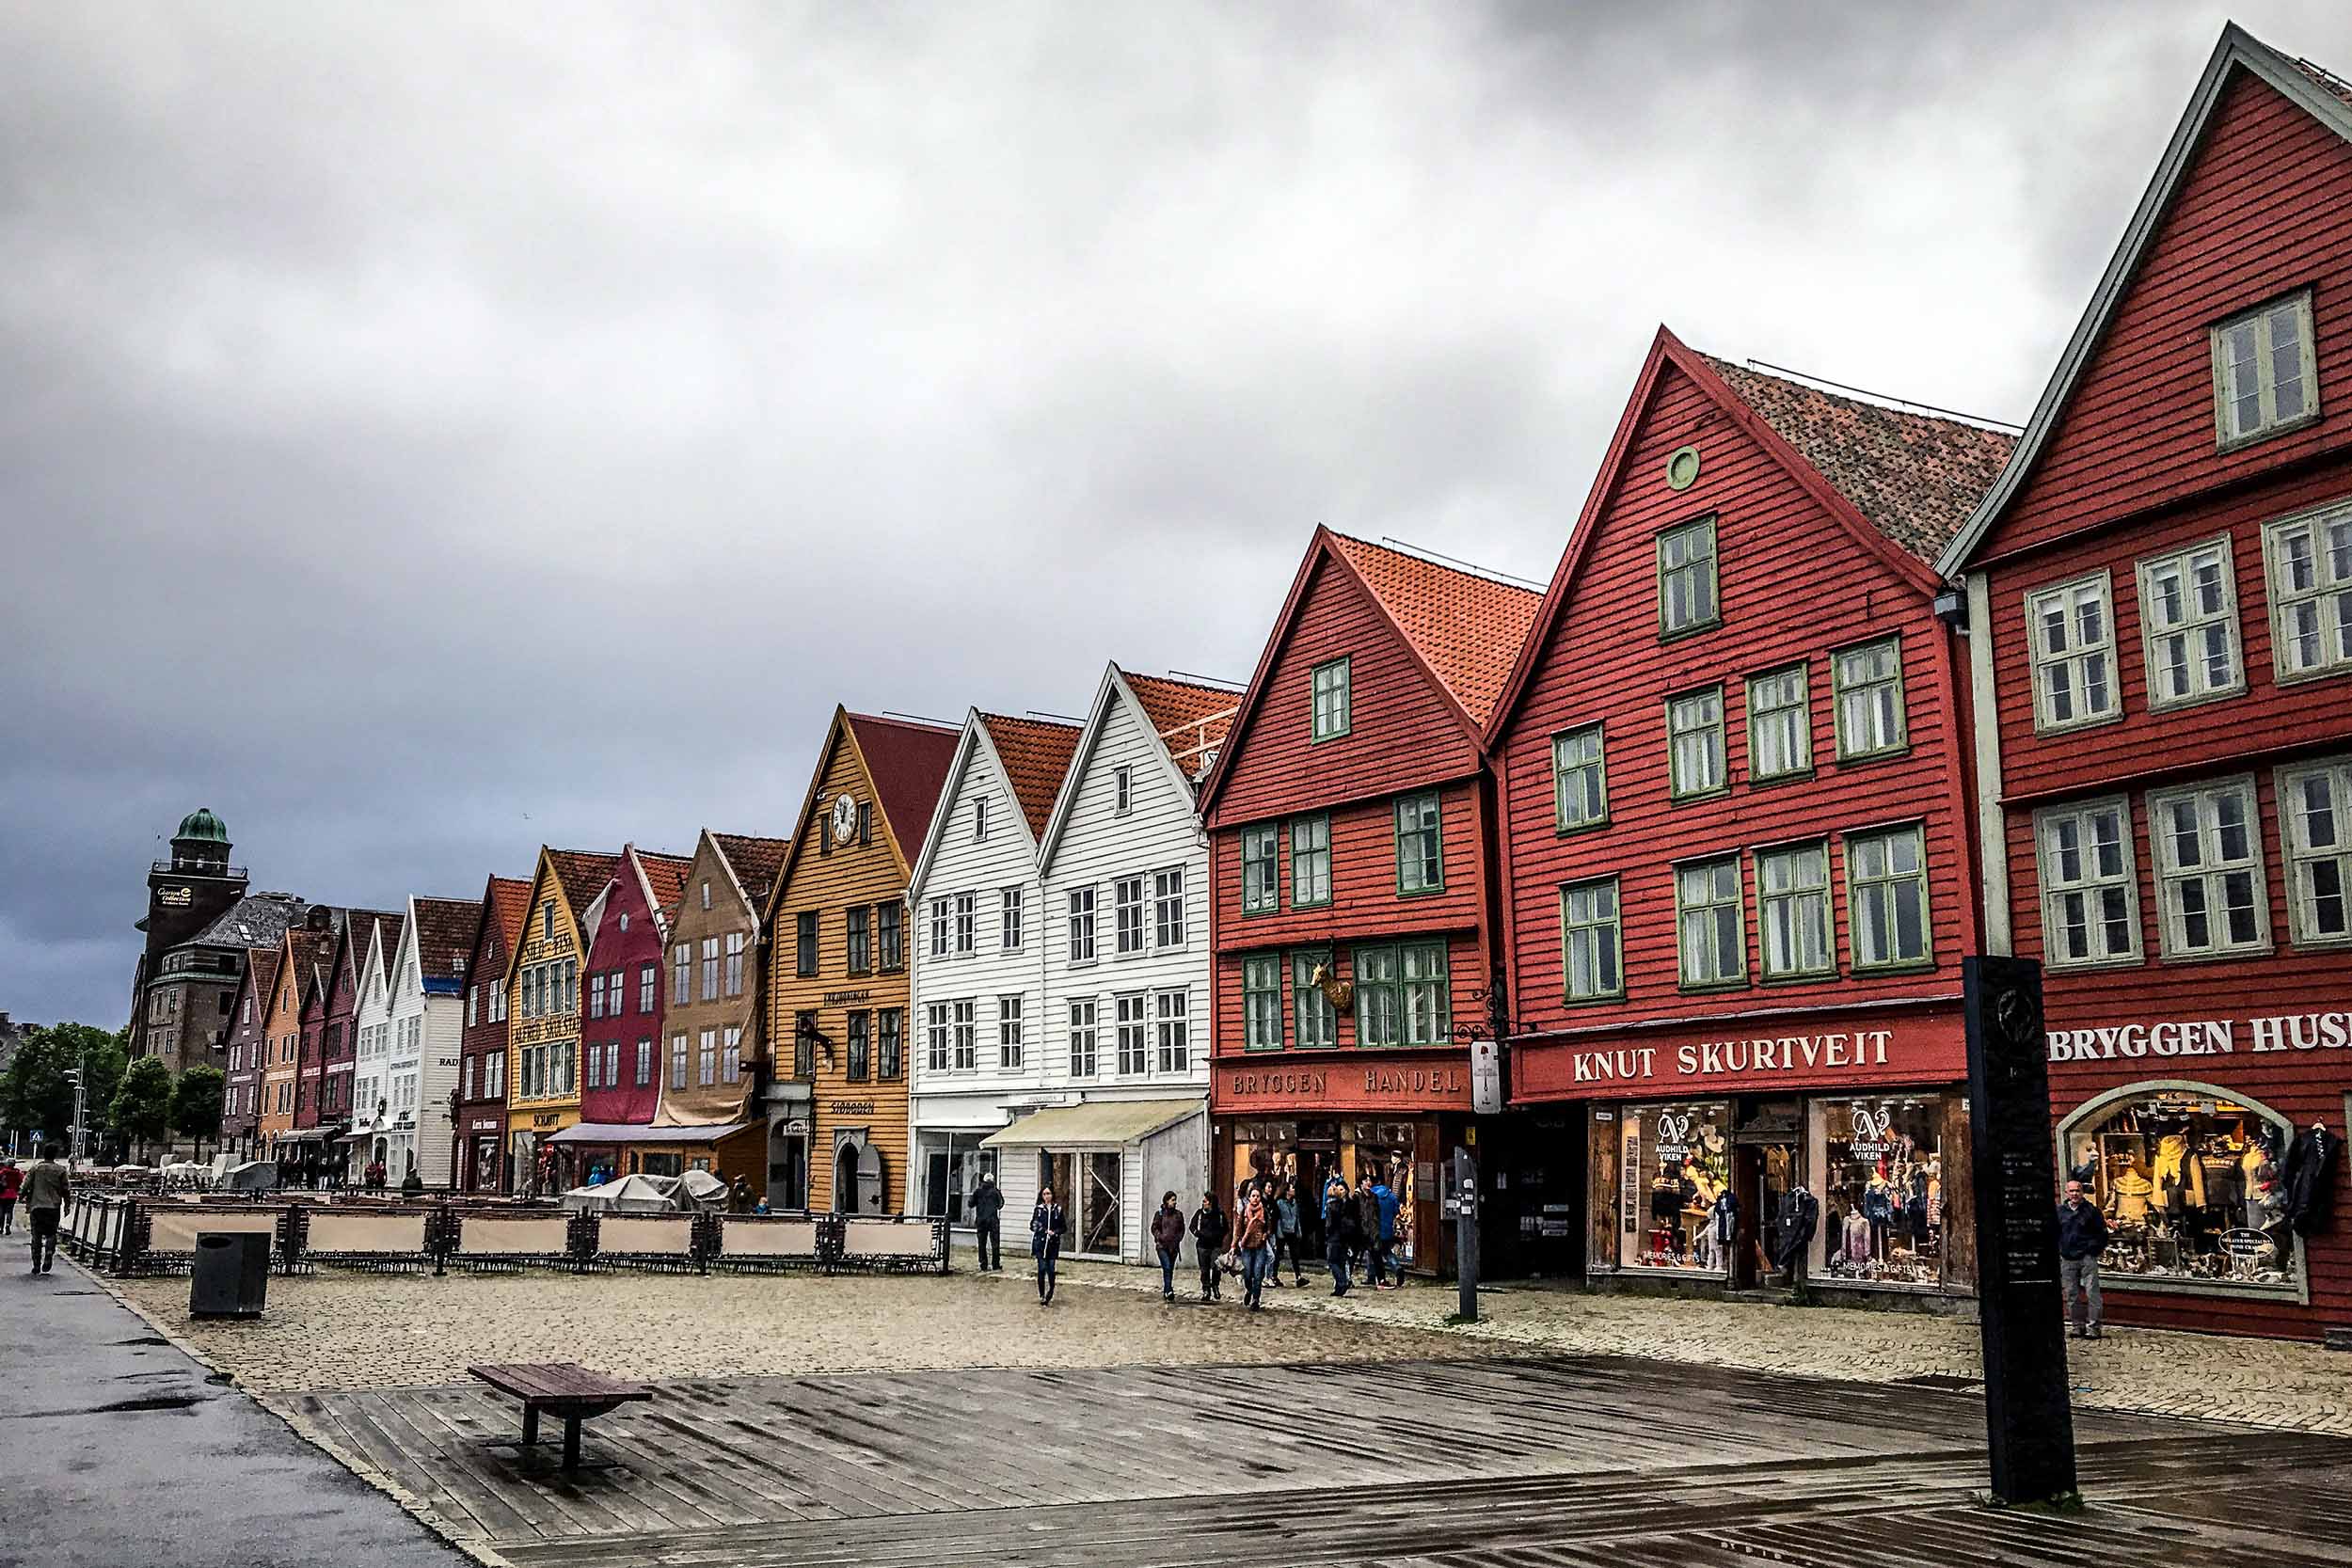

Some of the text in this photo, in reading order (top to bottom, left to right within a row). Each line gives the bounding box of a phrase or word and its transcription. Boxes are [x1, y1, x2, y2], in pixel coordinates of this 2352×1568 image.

[2045, 1012, 2352, 1062] BRYGGEN HUS
[1573, 1030, 1893, 1082] KNUT SKURTVEIT
[438, 1058, 459, 1067] RAD
[1233, 1069, 1462, 1095] BRYGGEN HANDEL
[1655, 1145, 1689, 1154] AUDHILD
[1849, 1143, 1891, 1152] AUDHILD
[1659, 1153, 1682, 1162] VIKEN
[1853, 1151, 1883, 1161] VIKEN
